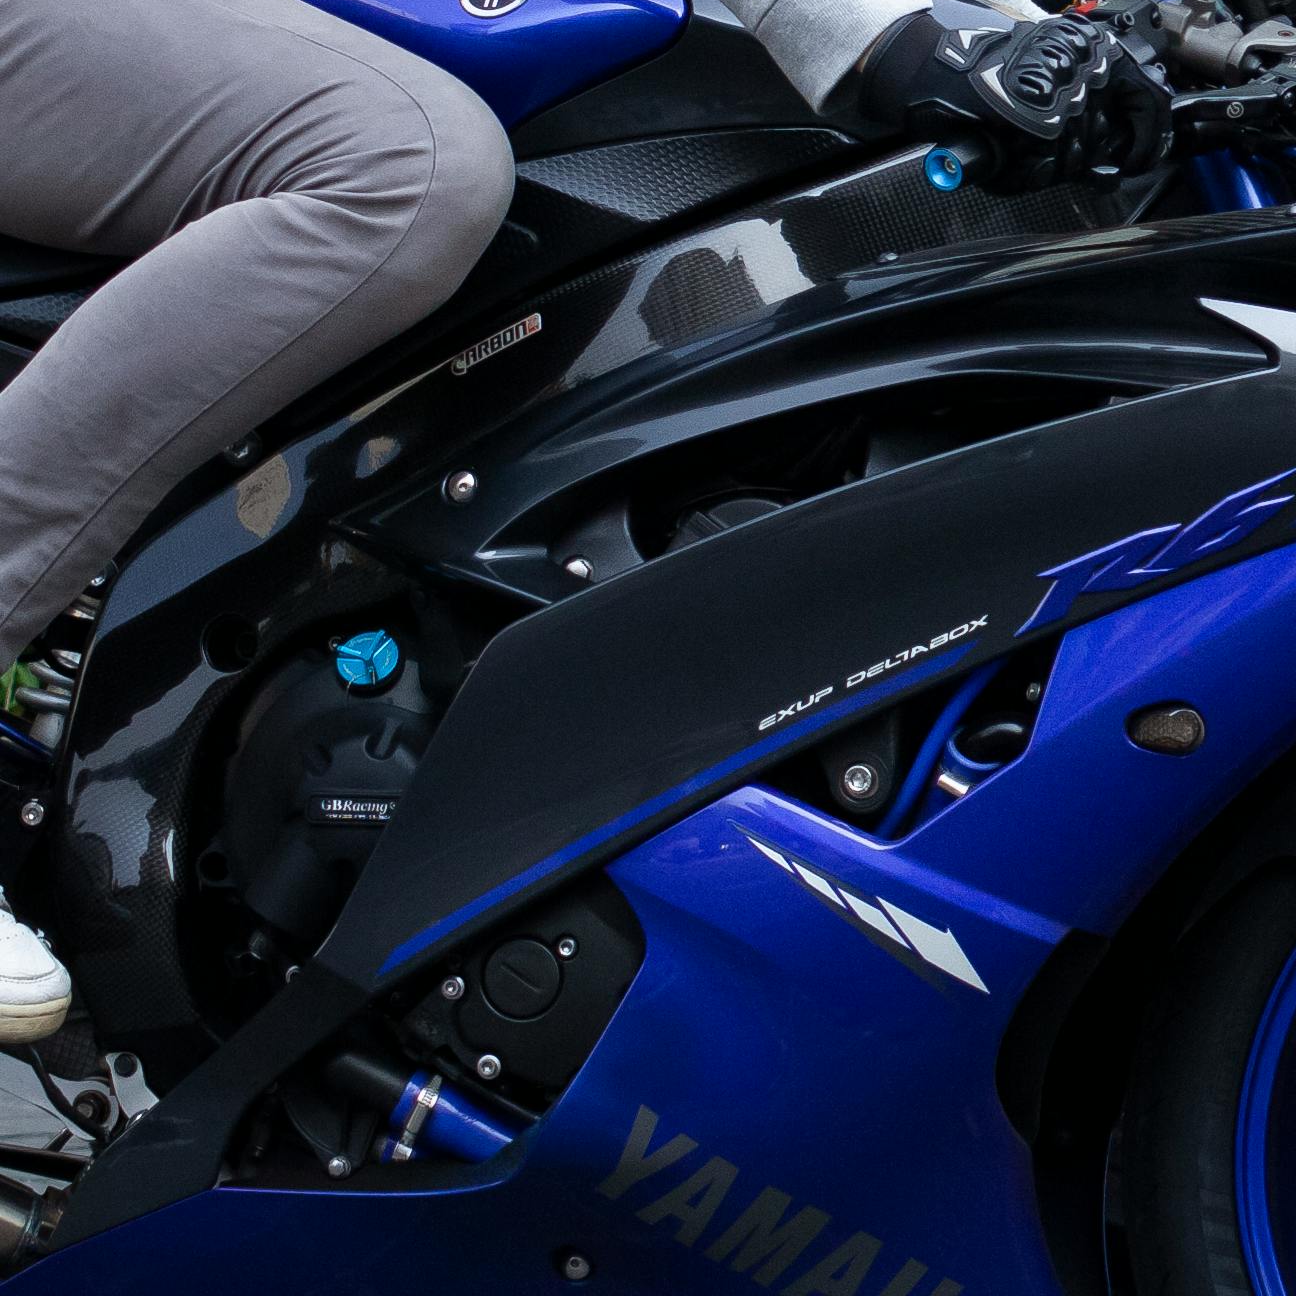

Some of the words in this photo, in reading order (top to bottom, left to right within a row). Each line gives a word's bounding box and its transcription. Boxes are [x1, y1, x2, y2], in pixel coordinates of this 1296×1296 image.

[758, 686, 833, 731] EXUP
[846, 614, 989, 689] DELTABOX
[321, 799, 388, 815] GBRacing
